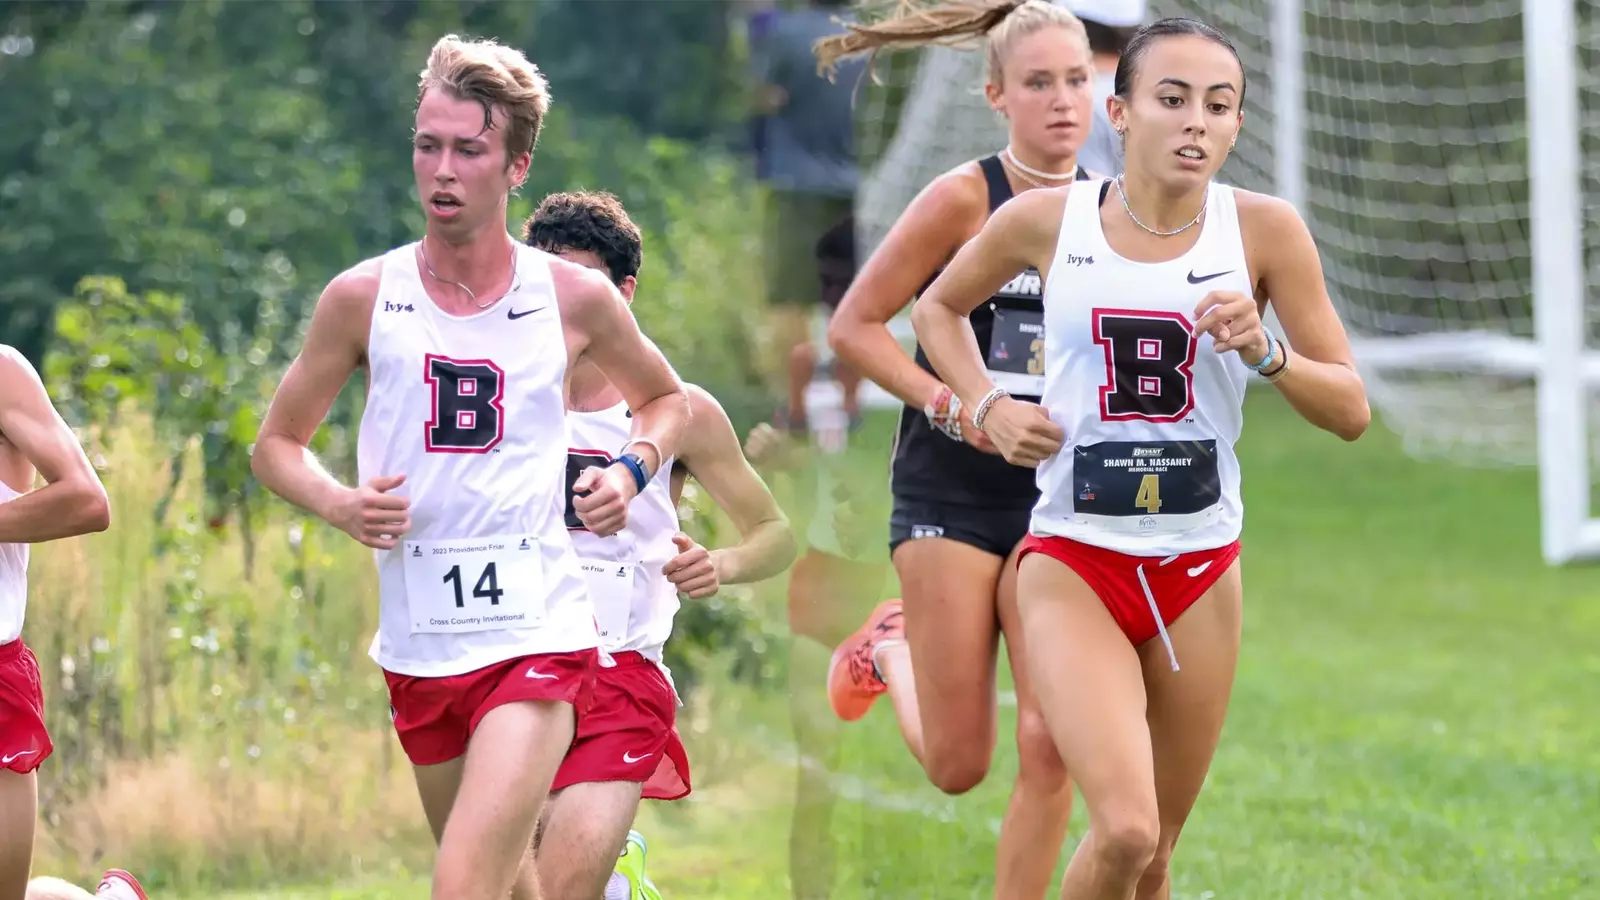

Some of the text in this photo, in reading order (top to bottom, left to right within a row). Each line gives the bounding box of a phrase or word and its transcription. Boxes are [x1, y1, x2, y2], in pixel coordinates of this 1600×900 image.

[1067, 254, 1084, 266] Ivy
[384, 301, 404, 312] Ivy
[1092, 308, 1198, 424] B
[424, 353, 505, 454] B
[1104, 458, 1192, 467] SHAWN M. NASSANEY
[1135, 474, 1162, 513] 4
[448, 545, 487, 553] Providence
[590, 565, 605, 573] Friar
[443, 562, 503, 608] 14
[451, 616, 480, 625] Country
[482, 612, 525, 623] Invitational
